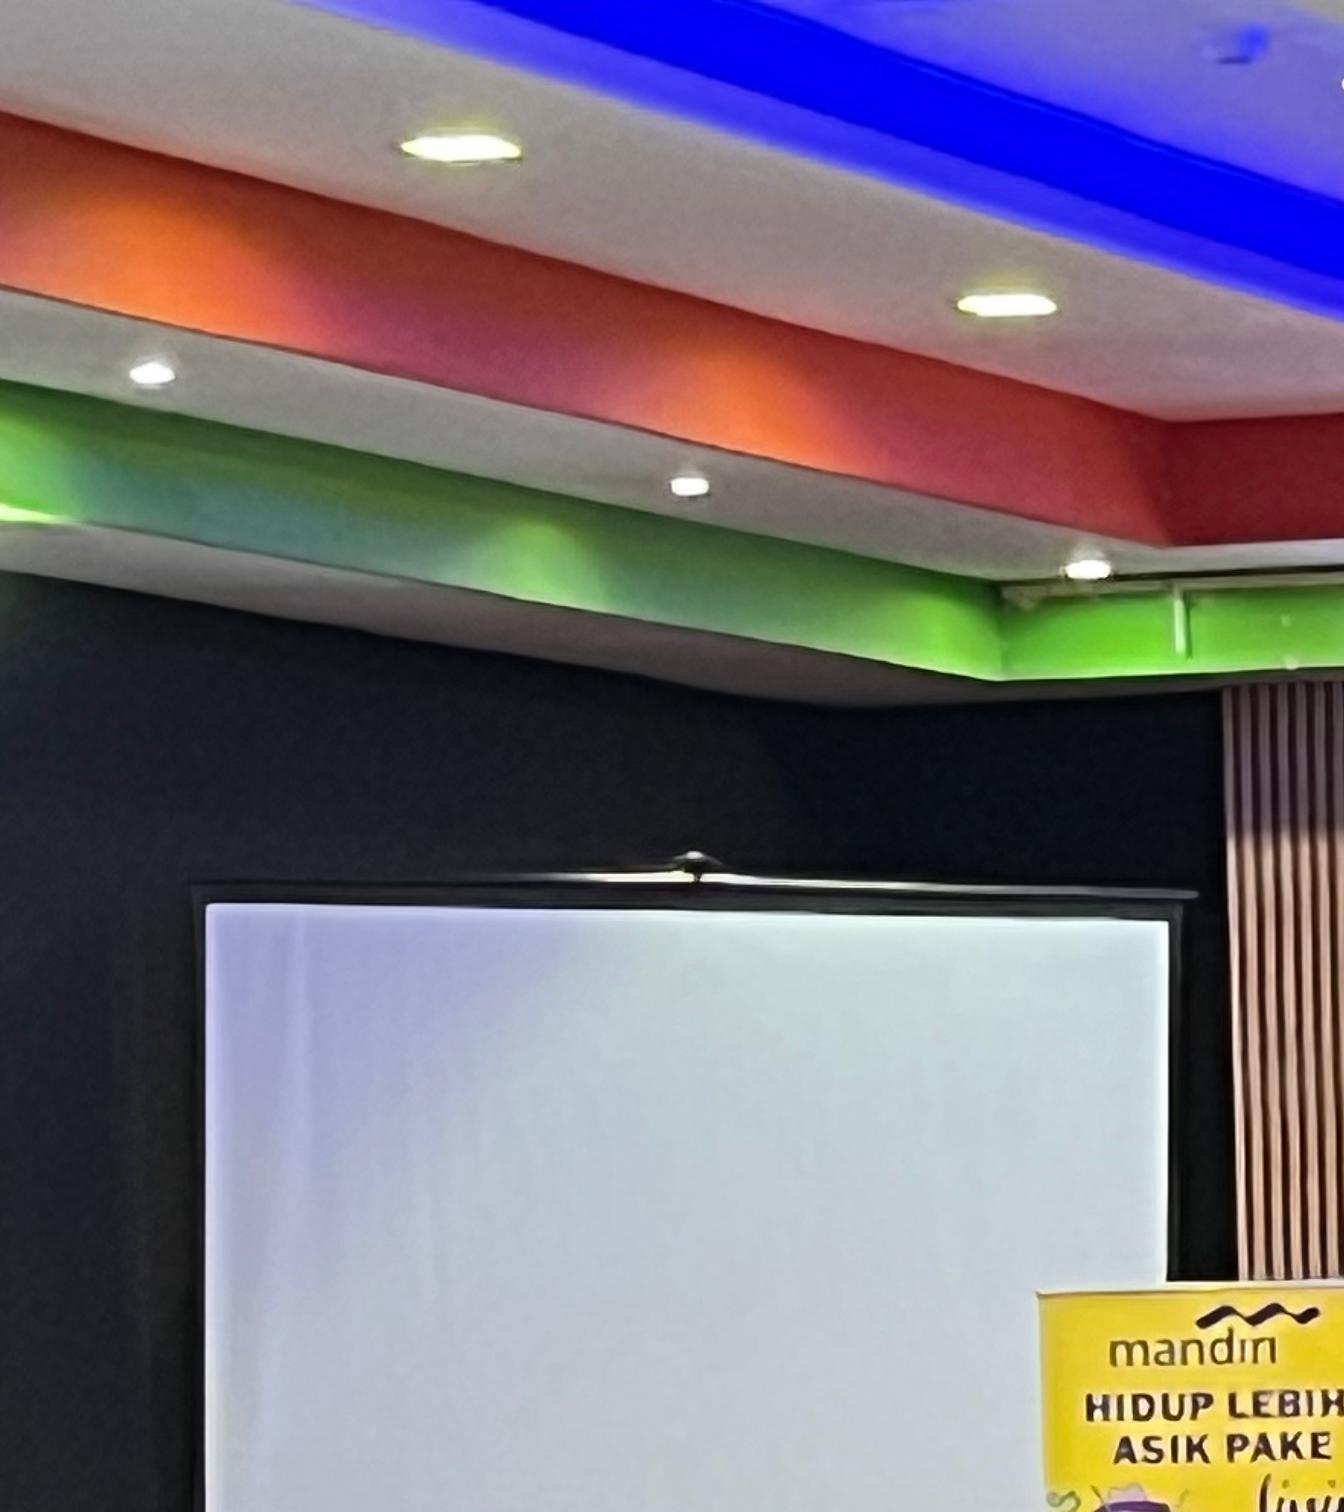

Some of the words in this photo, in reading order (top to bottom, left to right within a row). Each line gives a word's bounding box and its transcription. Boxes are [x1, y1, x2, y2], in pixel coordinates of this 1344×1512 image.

[1085, 1391, 1214, 1423] HIDUP
[1113, 1434, 1212, 1464] ASIK
[1226, 1430, 1333, 1463] PAKE
